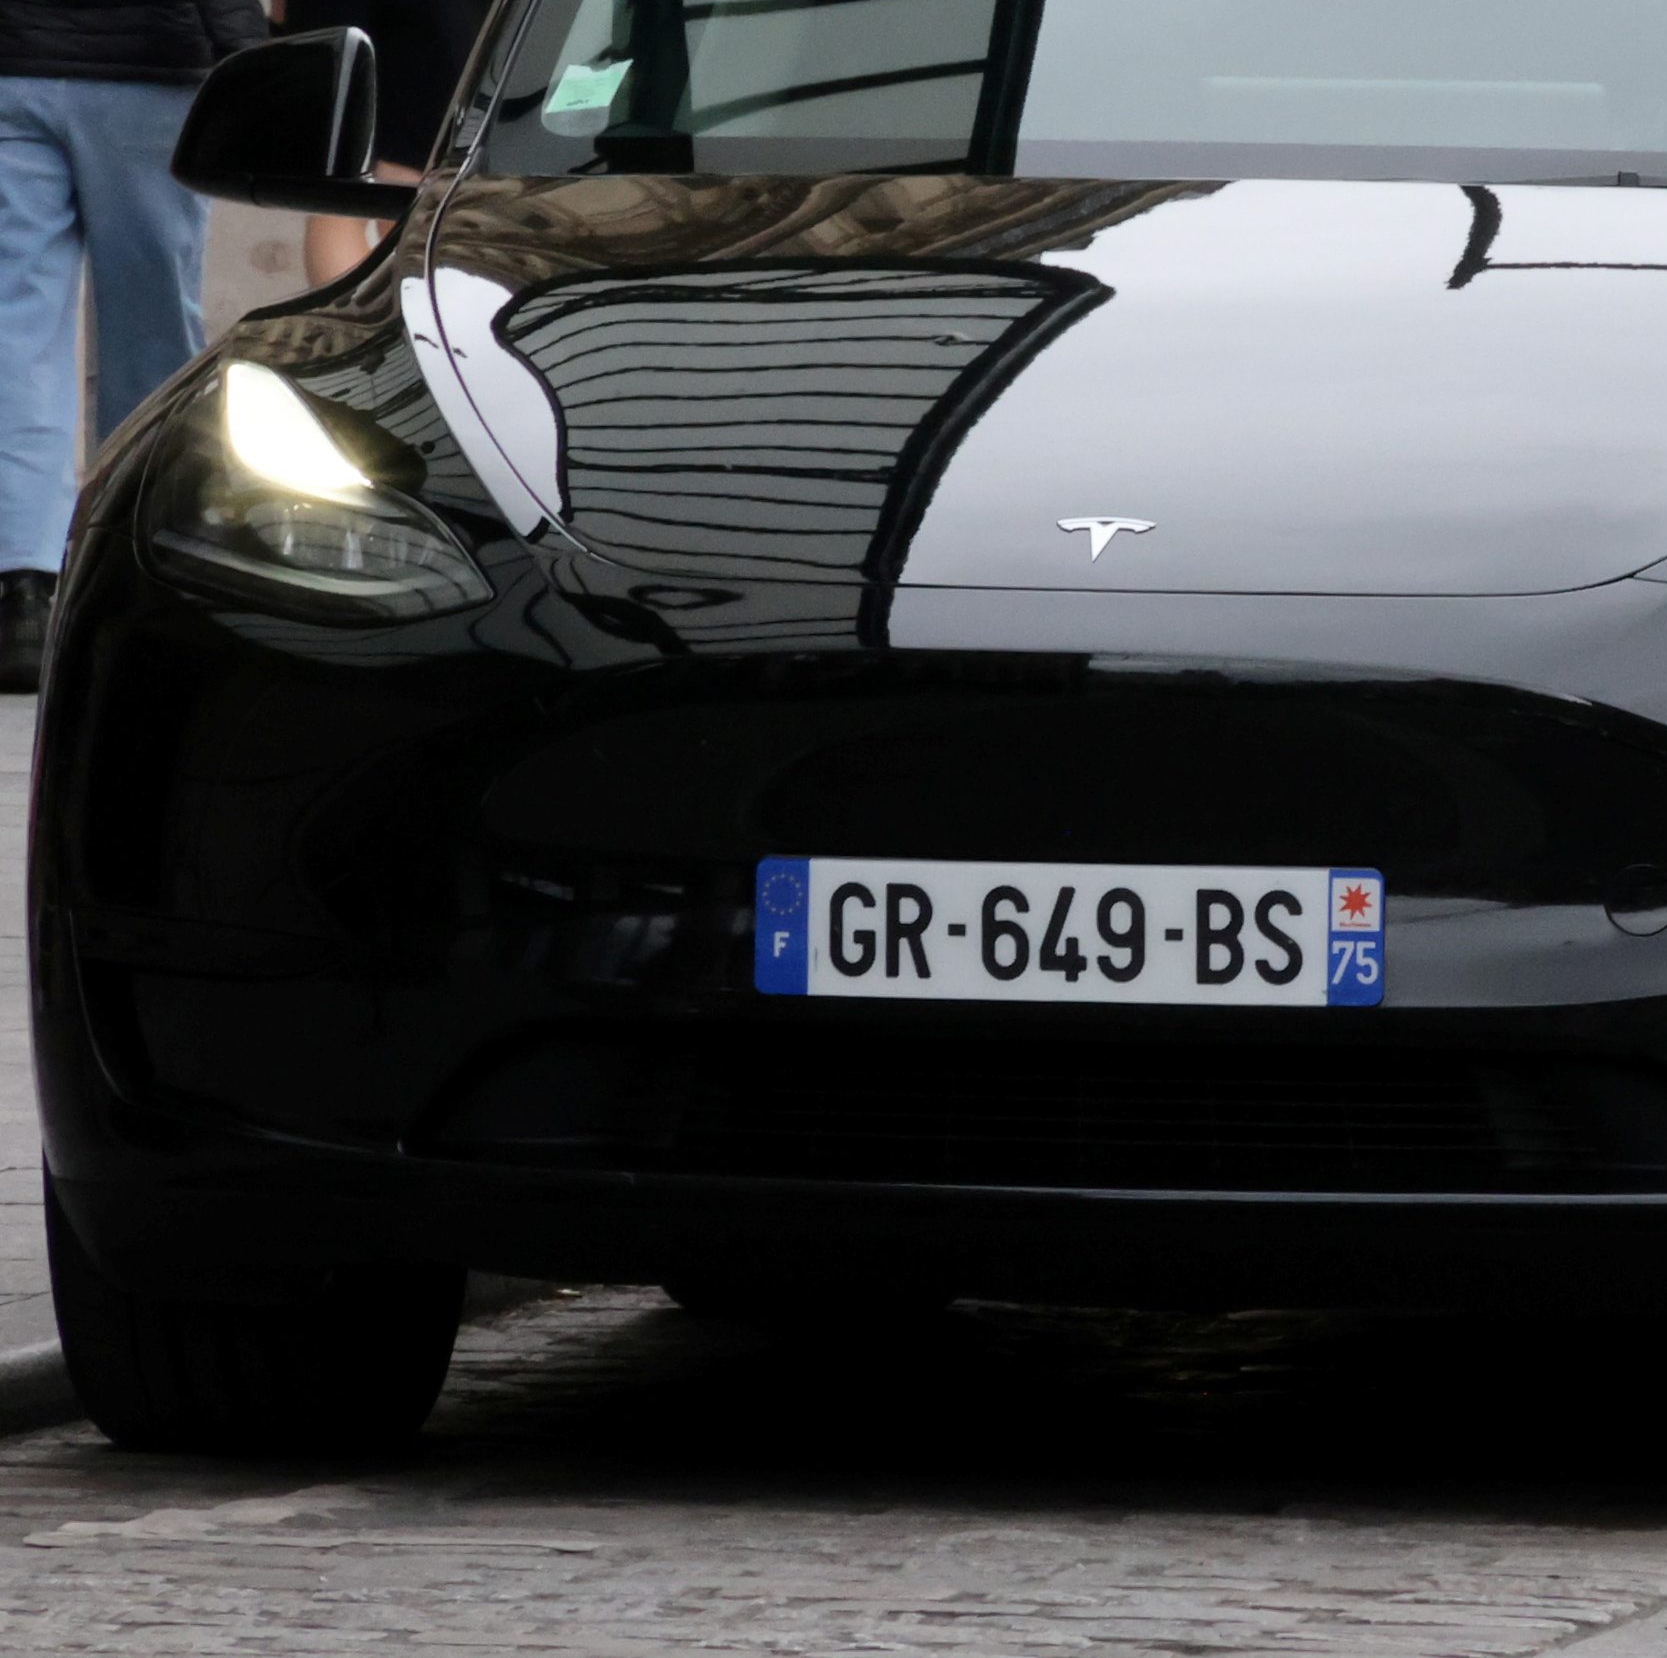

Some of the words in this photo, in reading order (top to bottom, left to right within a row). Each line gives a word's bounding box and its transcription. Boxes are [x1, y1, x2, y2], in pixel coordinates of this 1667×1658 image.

[773, 931, 790, 958] F
[828, 880, 1304, 986] GR-649-BS
[1331, 940, 1379, 986] 75
